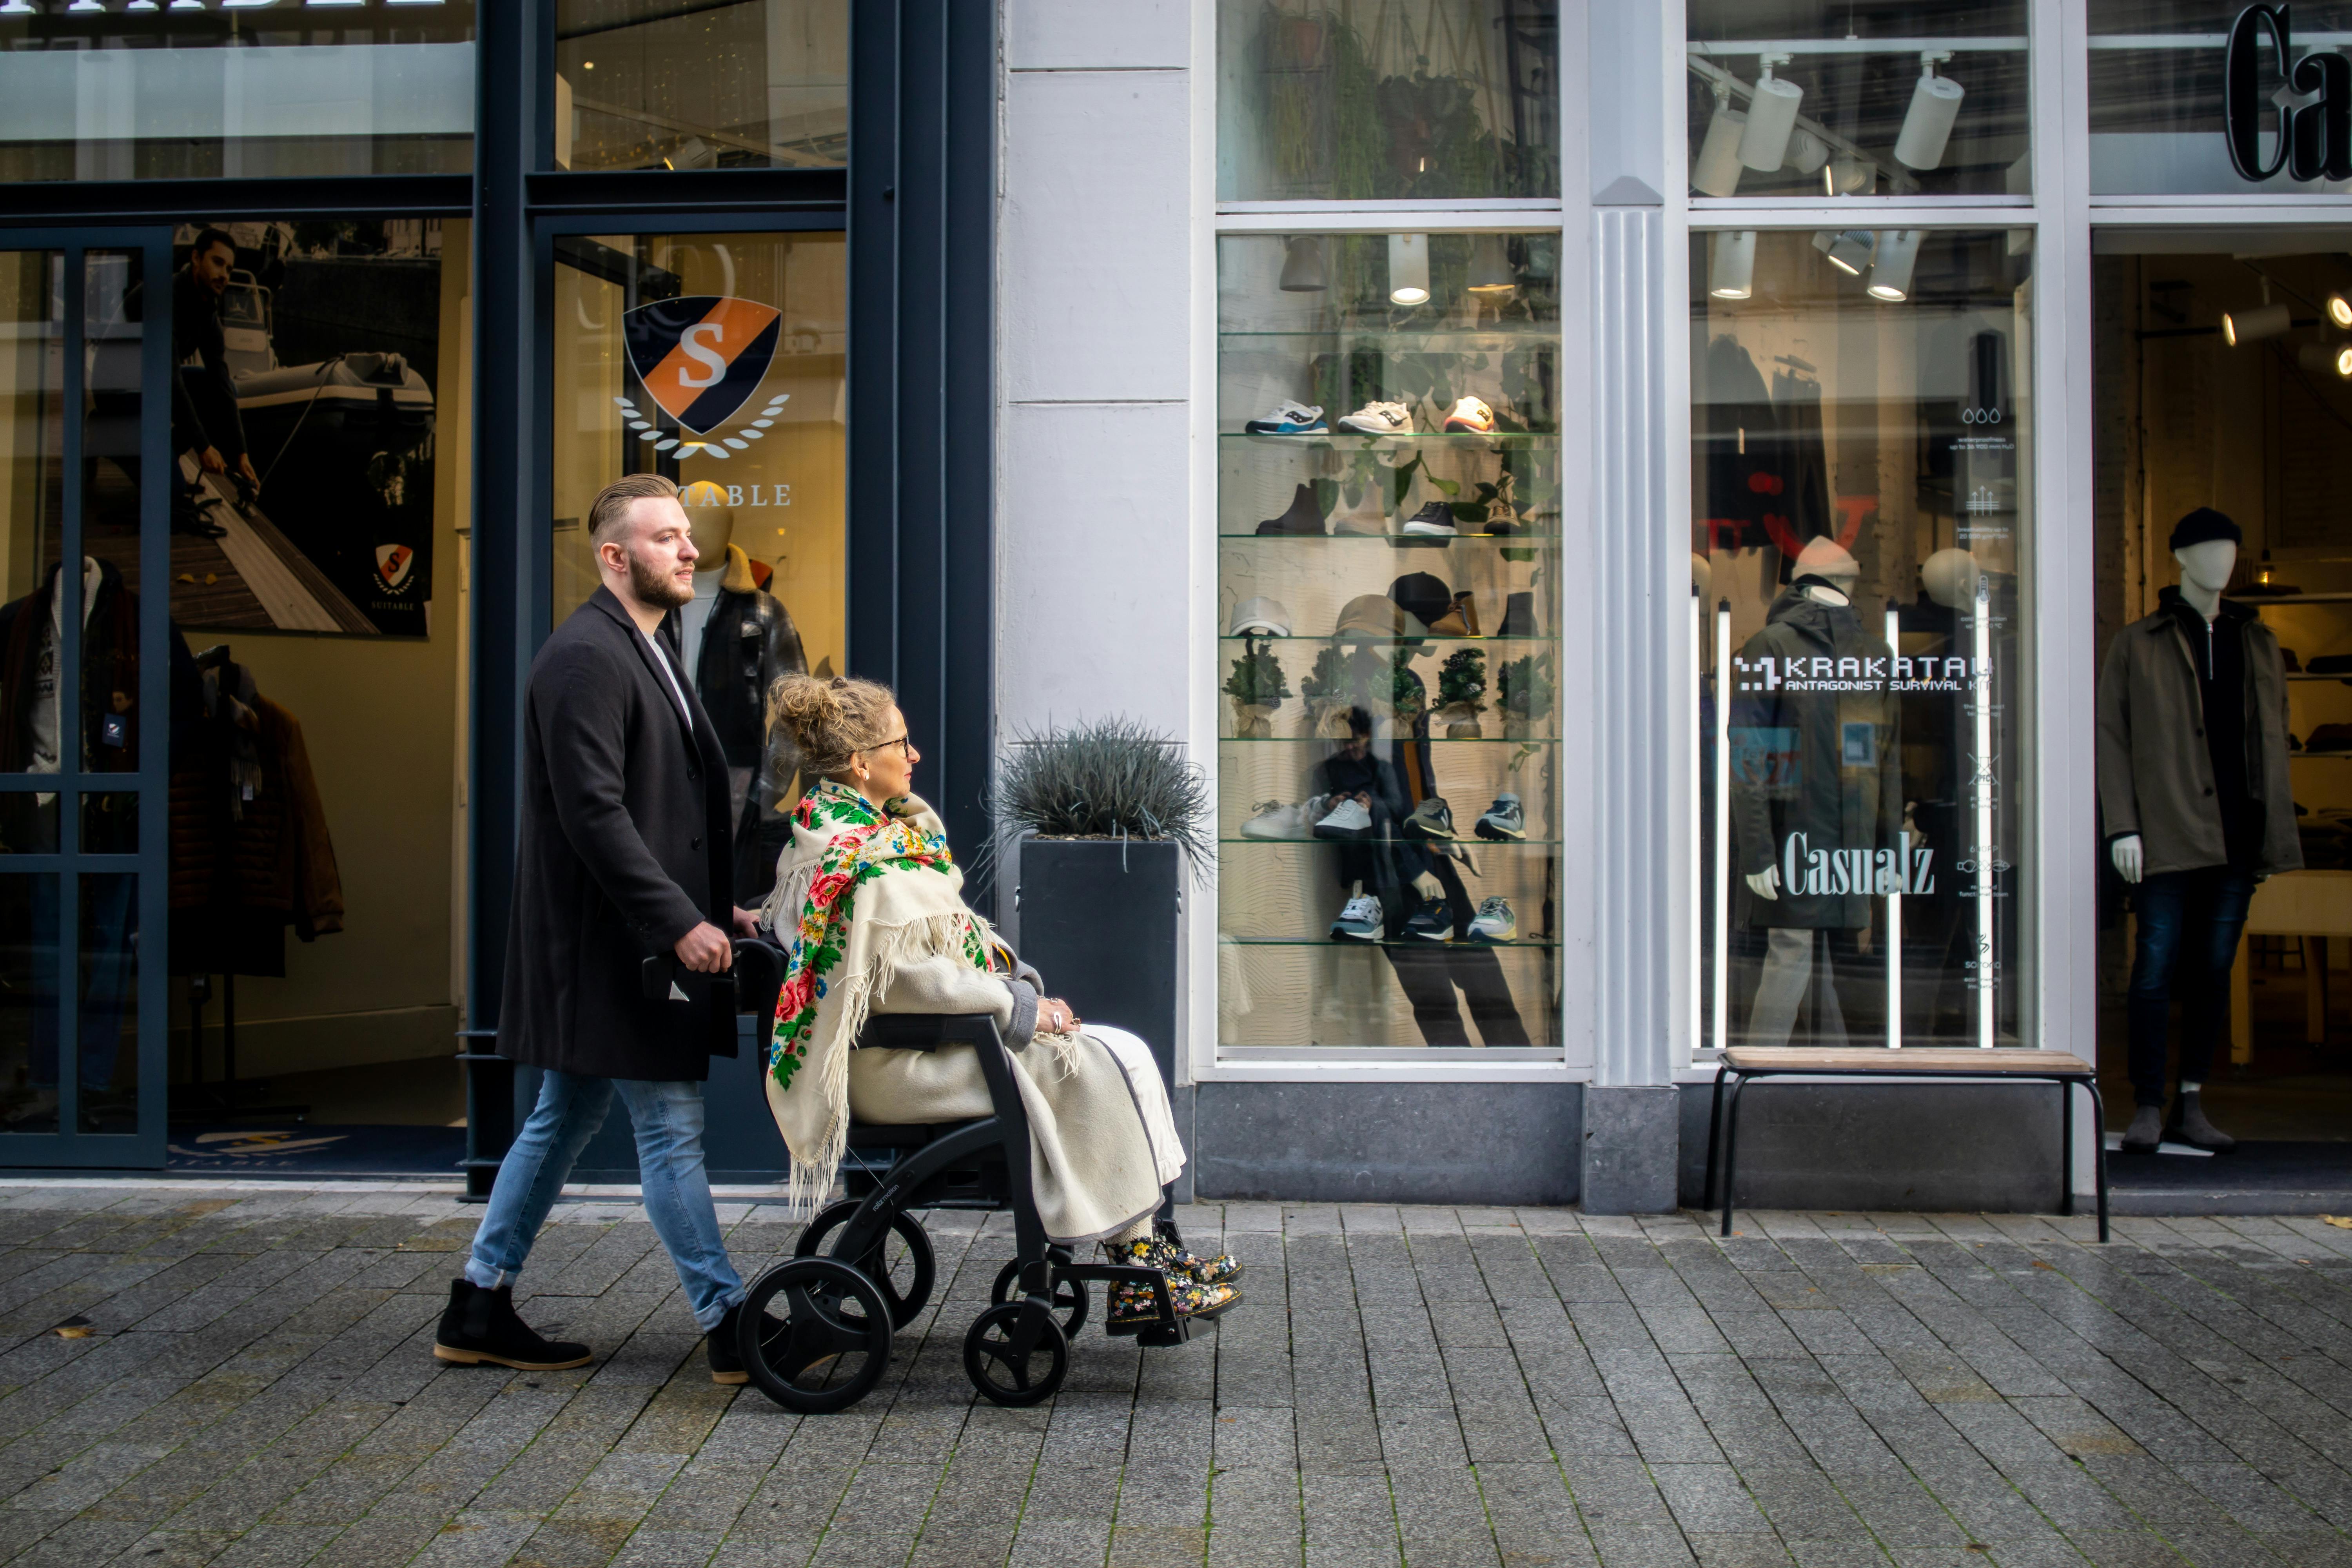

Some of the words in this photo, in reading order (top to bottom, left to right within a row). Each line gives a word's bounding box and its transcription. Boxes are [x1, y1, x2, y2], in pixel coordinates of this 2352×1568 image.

[679, 322, 726, 388] S
[678, 485, 791, 507] TABLE
[388, 552, 399, 573] S
[1785, 657, 1992, 677] KRAKATAU
[1786, 680, 1883, 691] ANTAGONIST
[1889, 680, 1962, 691] SURVIVAL
[1785, 831, 1935, 896] Casualz
[873, 1199, 884, 1212] rollz
[882, 1184, 900, 1201] motion
